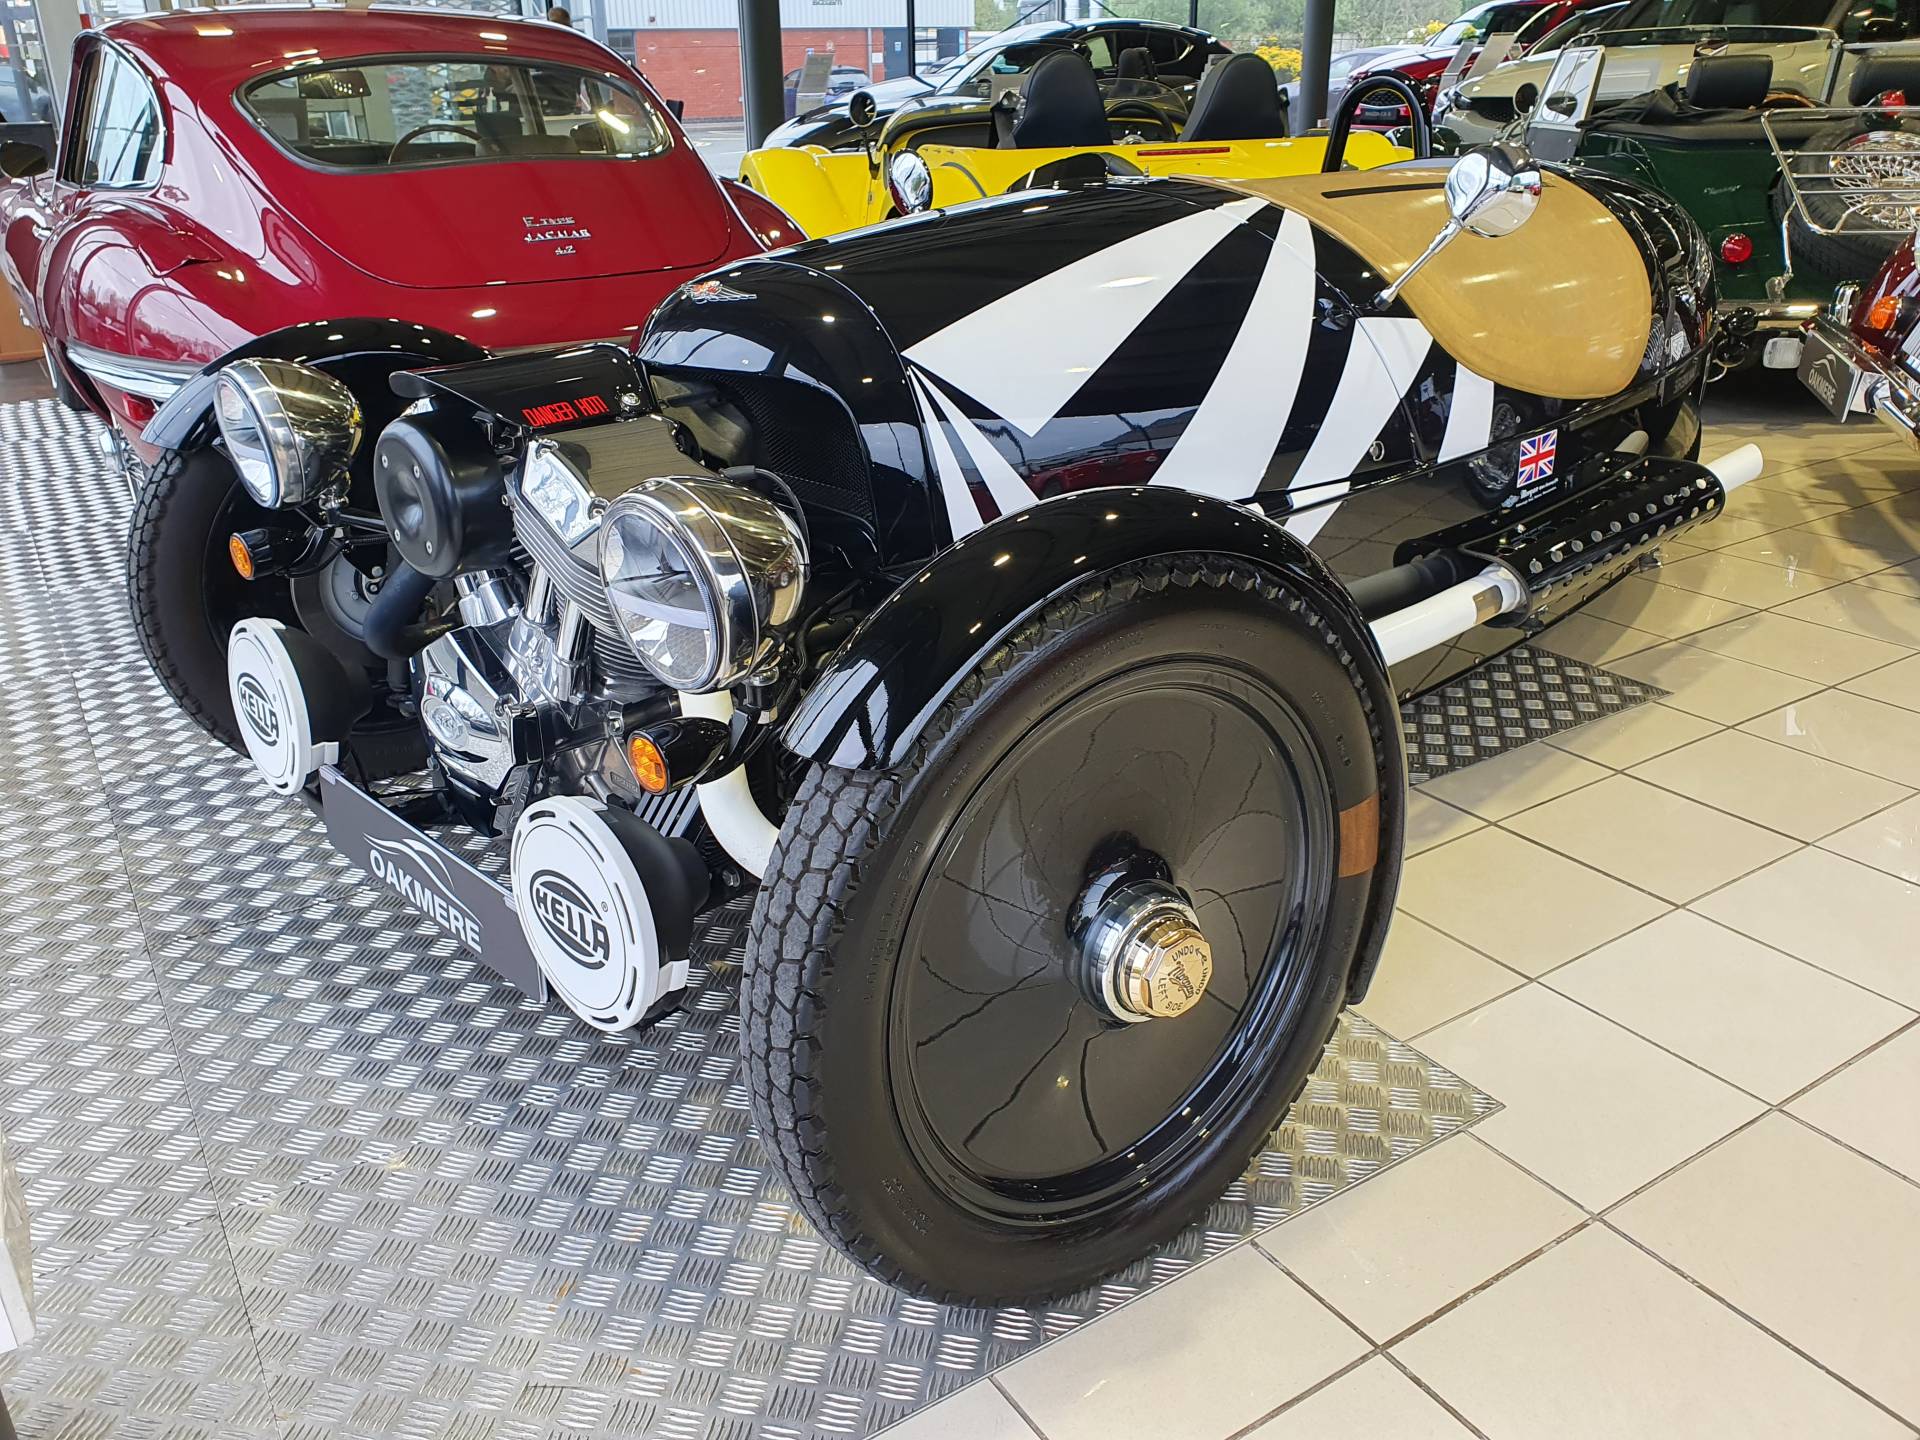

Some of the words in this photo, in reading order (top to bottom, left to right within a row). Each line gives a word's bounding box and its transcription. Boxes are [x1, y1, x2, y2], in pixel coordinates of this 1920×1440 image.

[1808, 368, 1836, 406] OAKMERE
[521, 402, 579, 428] DANGER
[240, 686, 279, 739] HELLA
[369, 849, 482, 954] OAKMERE
[535, 887, 610, 962] HELLA
[1171, 944, 1194, 962] UNDO
[1157, 977, 1168, 1001] LEFT
[1165, 1001, 1183, 1011] SIDE
